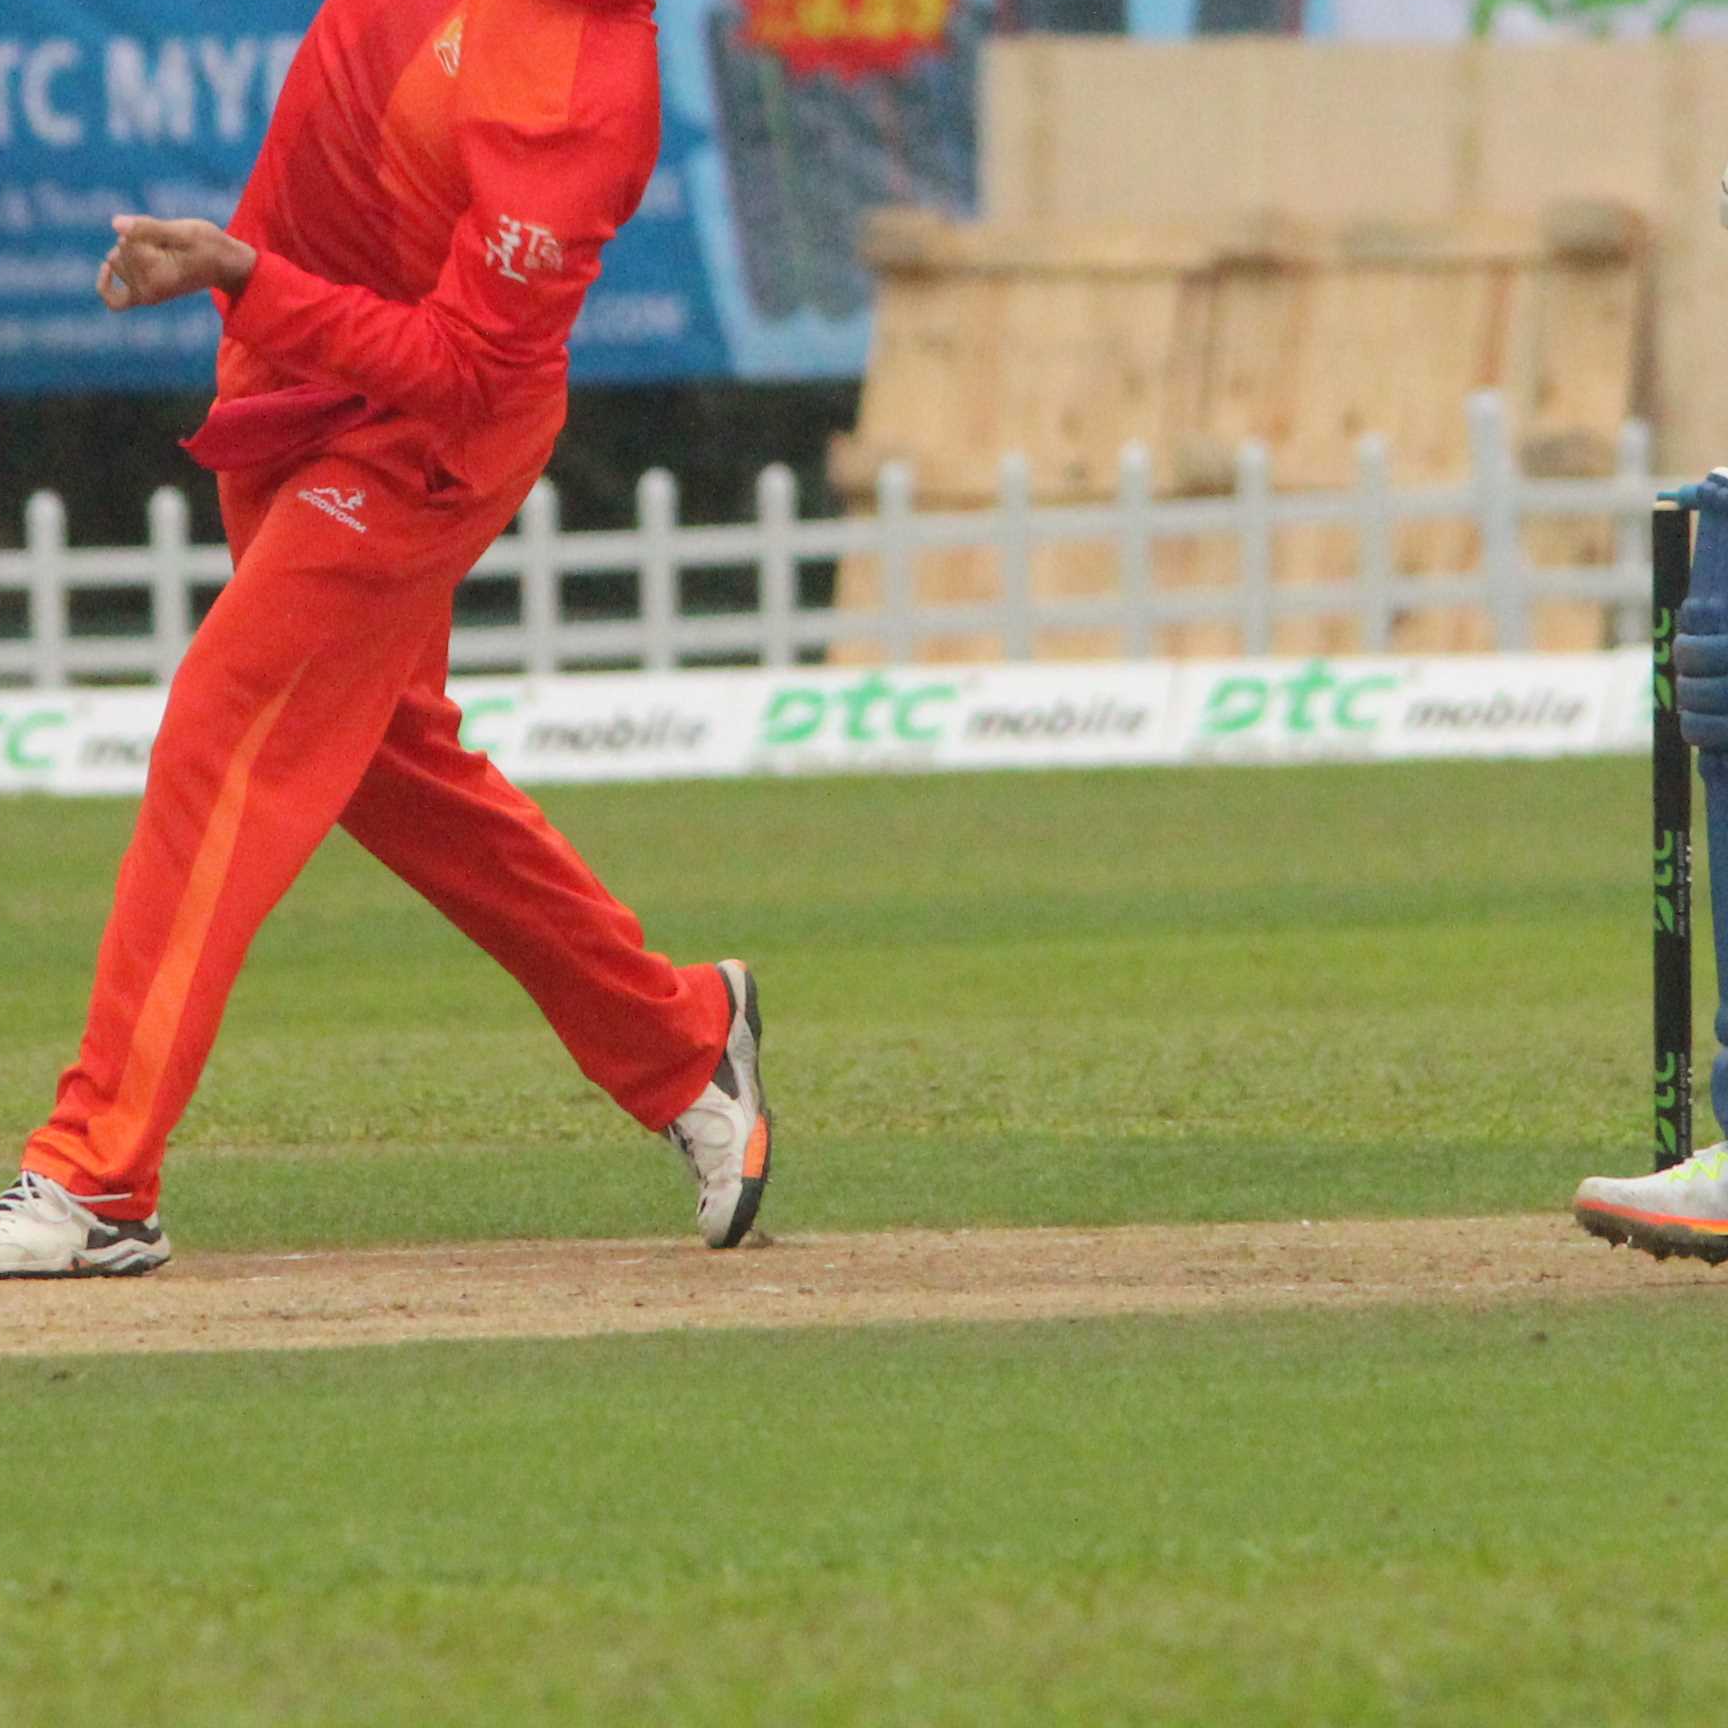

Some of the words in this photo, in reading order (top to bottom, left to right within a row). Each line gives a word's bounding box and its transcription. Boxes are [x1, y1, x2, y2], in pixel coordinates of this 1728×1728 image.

[525, 705, 710, 754] mobile
[964, 690, 1150, 740] mobile
[1404, 684, 1588, 730] mobile
